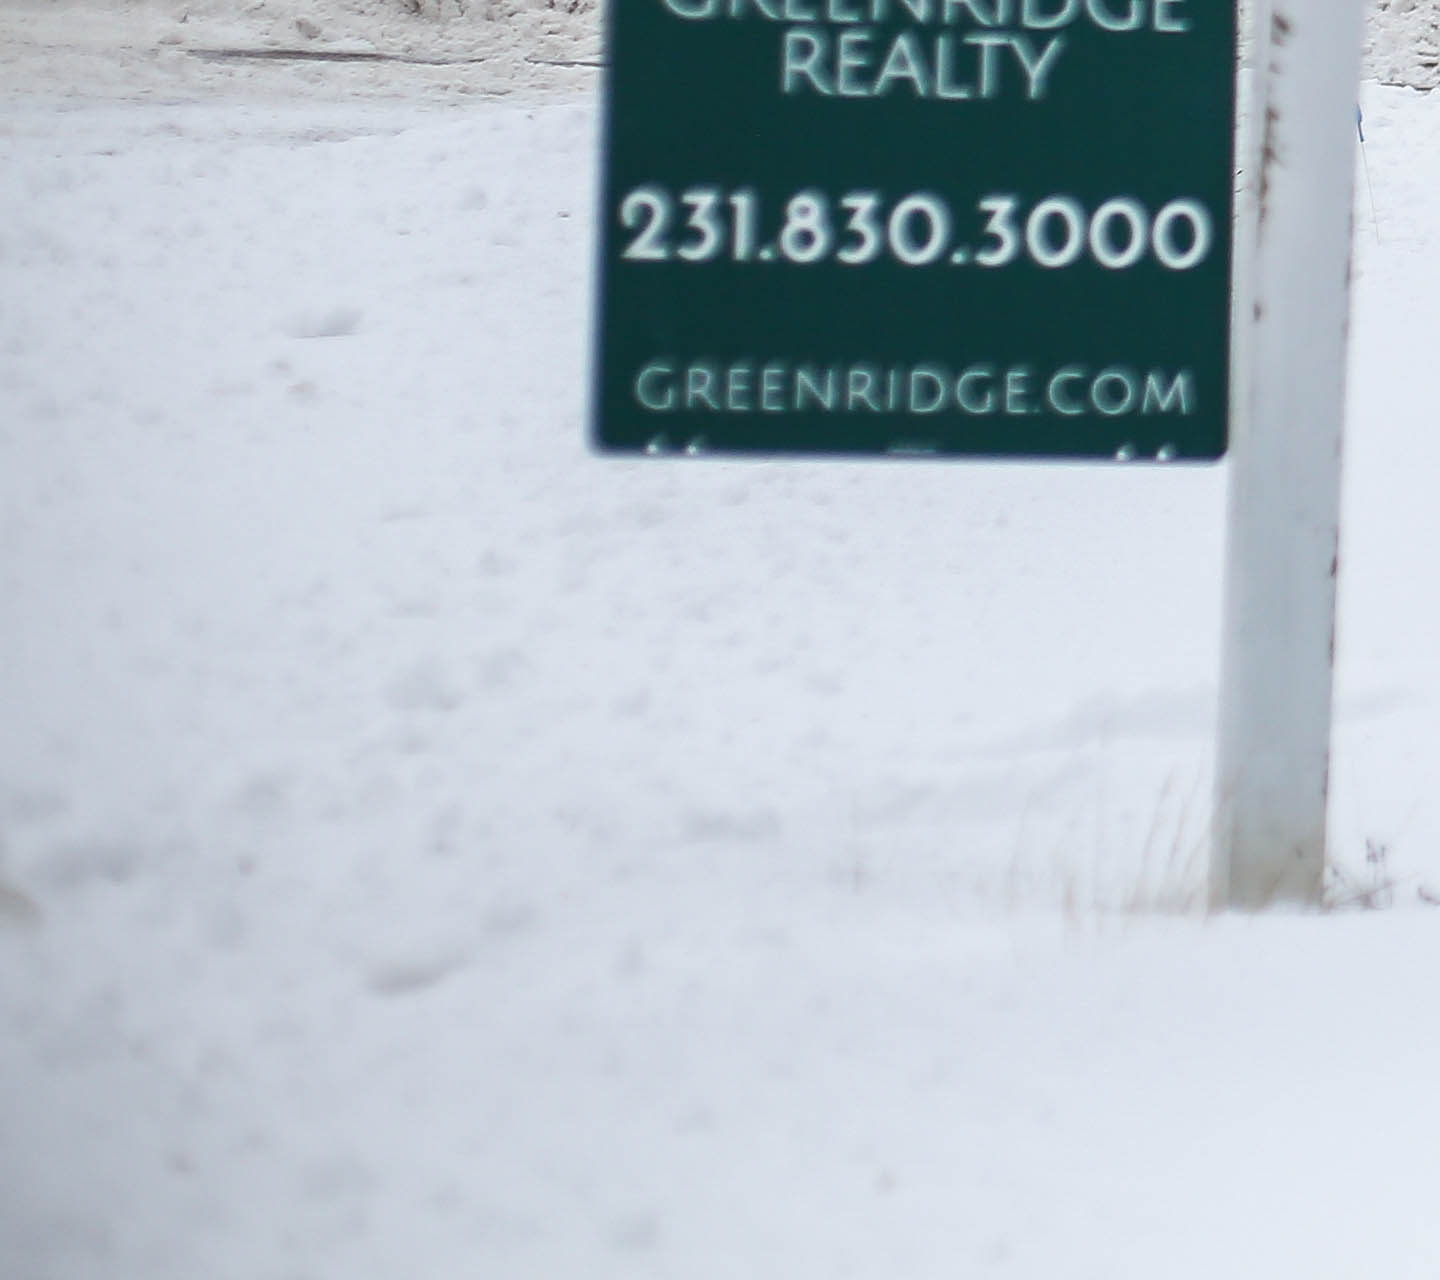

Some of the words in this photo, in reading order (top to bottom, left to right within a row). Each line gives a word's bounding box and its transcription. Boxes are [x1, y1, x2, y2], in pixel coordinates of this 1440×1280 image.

[780, 30, 1066, 101] REALTY
[620, 190, 1211, 269] 231.830.3000
[636, 366, 1193, 415] GREENRIDGE.COM
